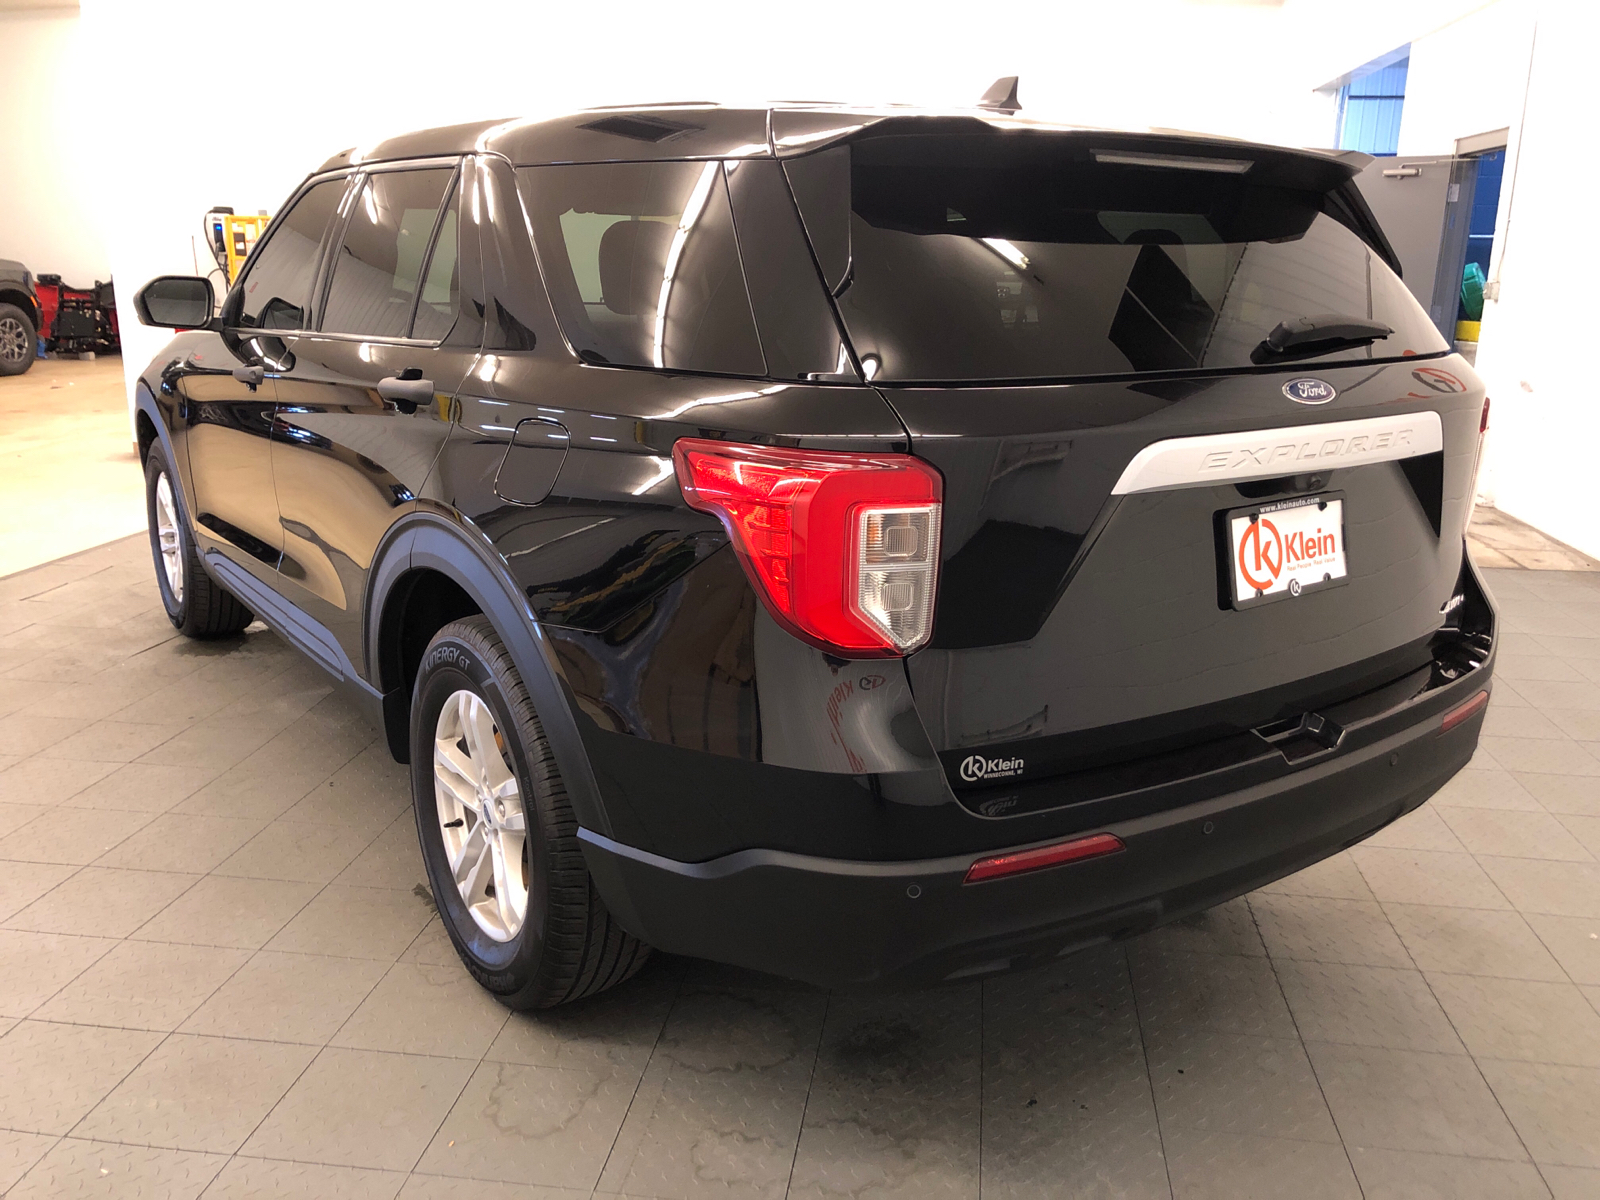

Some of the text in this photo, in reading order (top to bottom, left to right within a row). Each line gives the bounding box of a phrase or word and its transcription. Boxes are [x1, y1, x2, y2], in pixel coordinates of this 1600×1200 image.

[1297, 381, 1327, 398] Ford
[1198, 428, 1414, 473] EXPLORER
[1260, 497, 1320, 514] www.kleinauto.com
[1284, 527, 1336, 564] Klein
[458, 655, 471, 671] GT
[987, 757, 1025, 773] Klein
